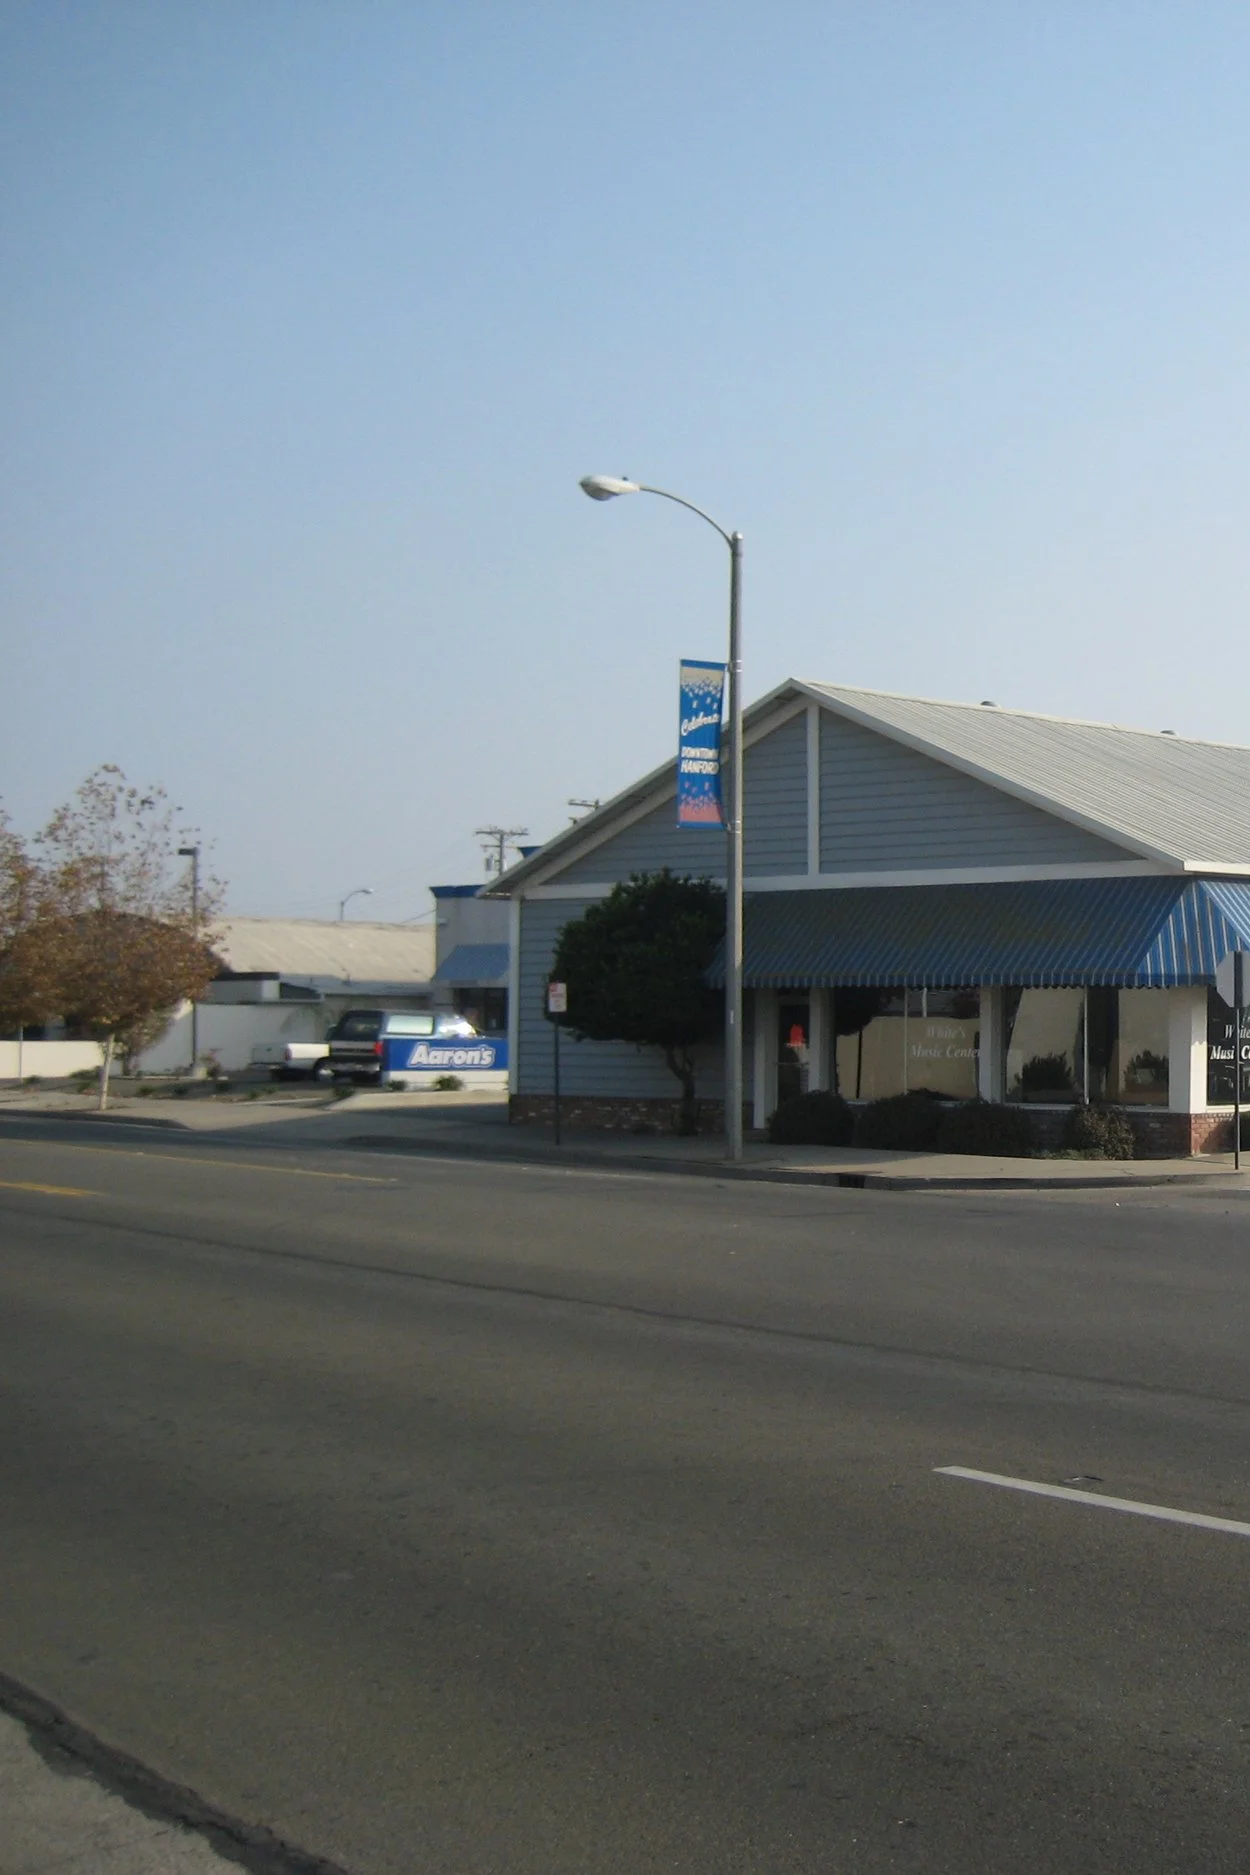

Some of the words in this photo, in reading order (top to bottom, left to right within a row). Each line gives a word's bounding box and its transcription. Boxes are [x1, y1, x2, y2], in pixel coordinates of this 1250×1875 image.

[680, 759, 719, 775] HANFORD
[409, 1042, 496, 1067] Aaron's
[1210, 1045, 1237, 1060] Musi
